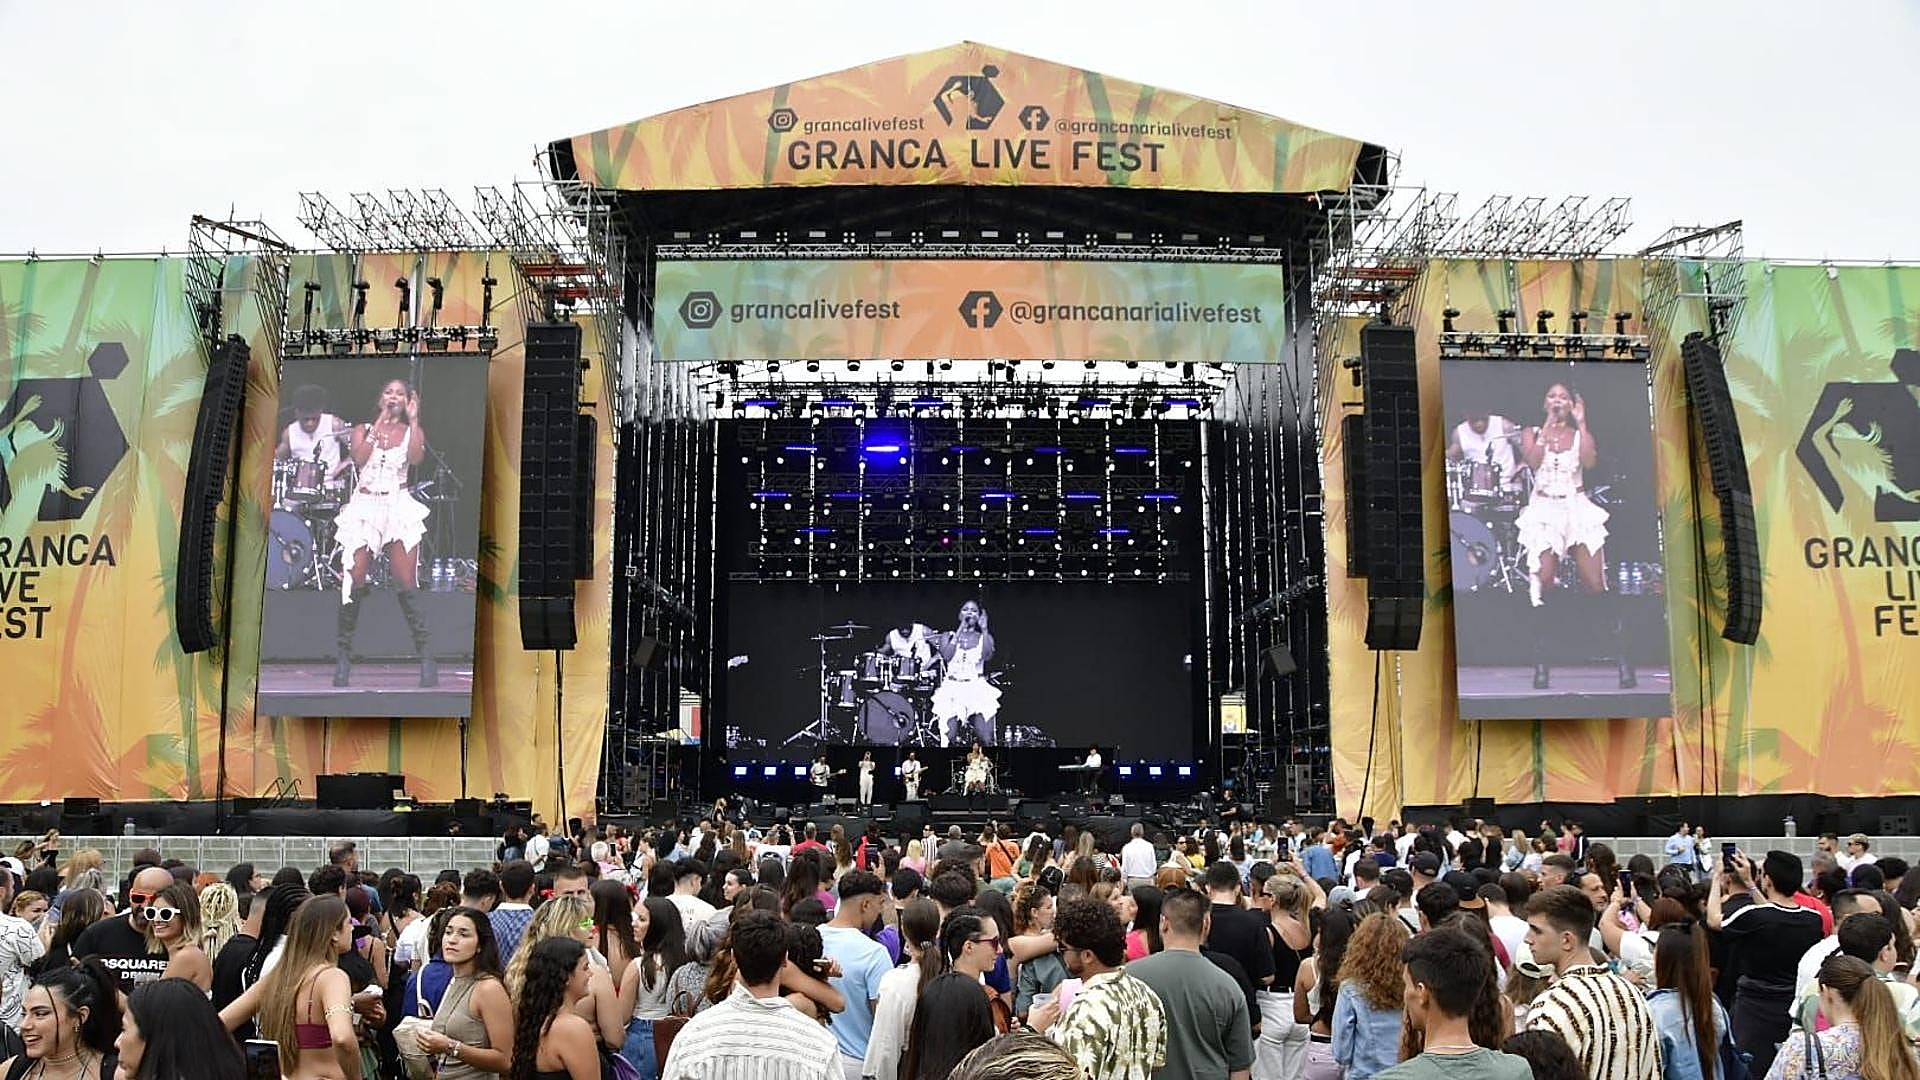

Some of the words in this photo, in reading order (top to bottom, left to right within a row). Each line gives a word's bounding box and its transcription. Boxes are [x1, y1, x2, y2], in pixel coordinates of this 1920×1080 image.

[804, 117, 925, 134] grancalivefest
[1055, 118, 1232, 140] @grancanarialivefest
[788, 139, 948, 170] GRANCA
[971, 139, 1051, 170] LIVE
[1072, 141, 1165, 173] FEST
[731, 298, 900, 323] grancalivefest
[1010, 301, 1261, 325] @grancanarialivefest
[1885, 570, 1920, 601] LI
[0, 606, 51, 639] ST
[100, 958, 169, 970] SQUARE
